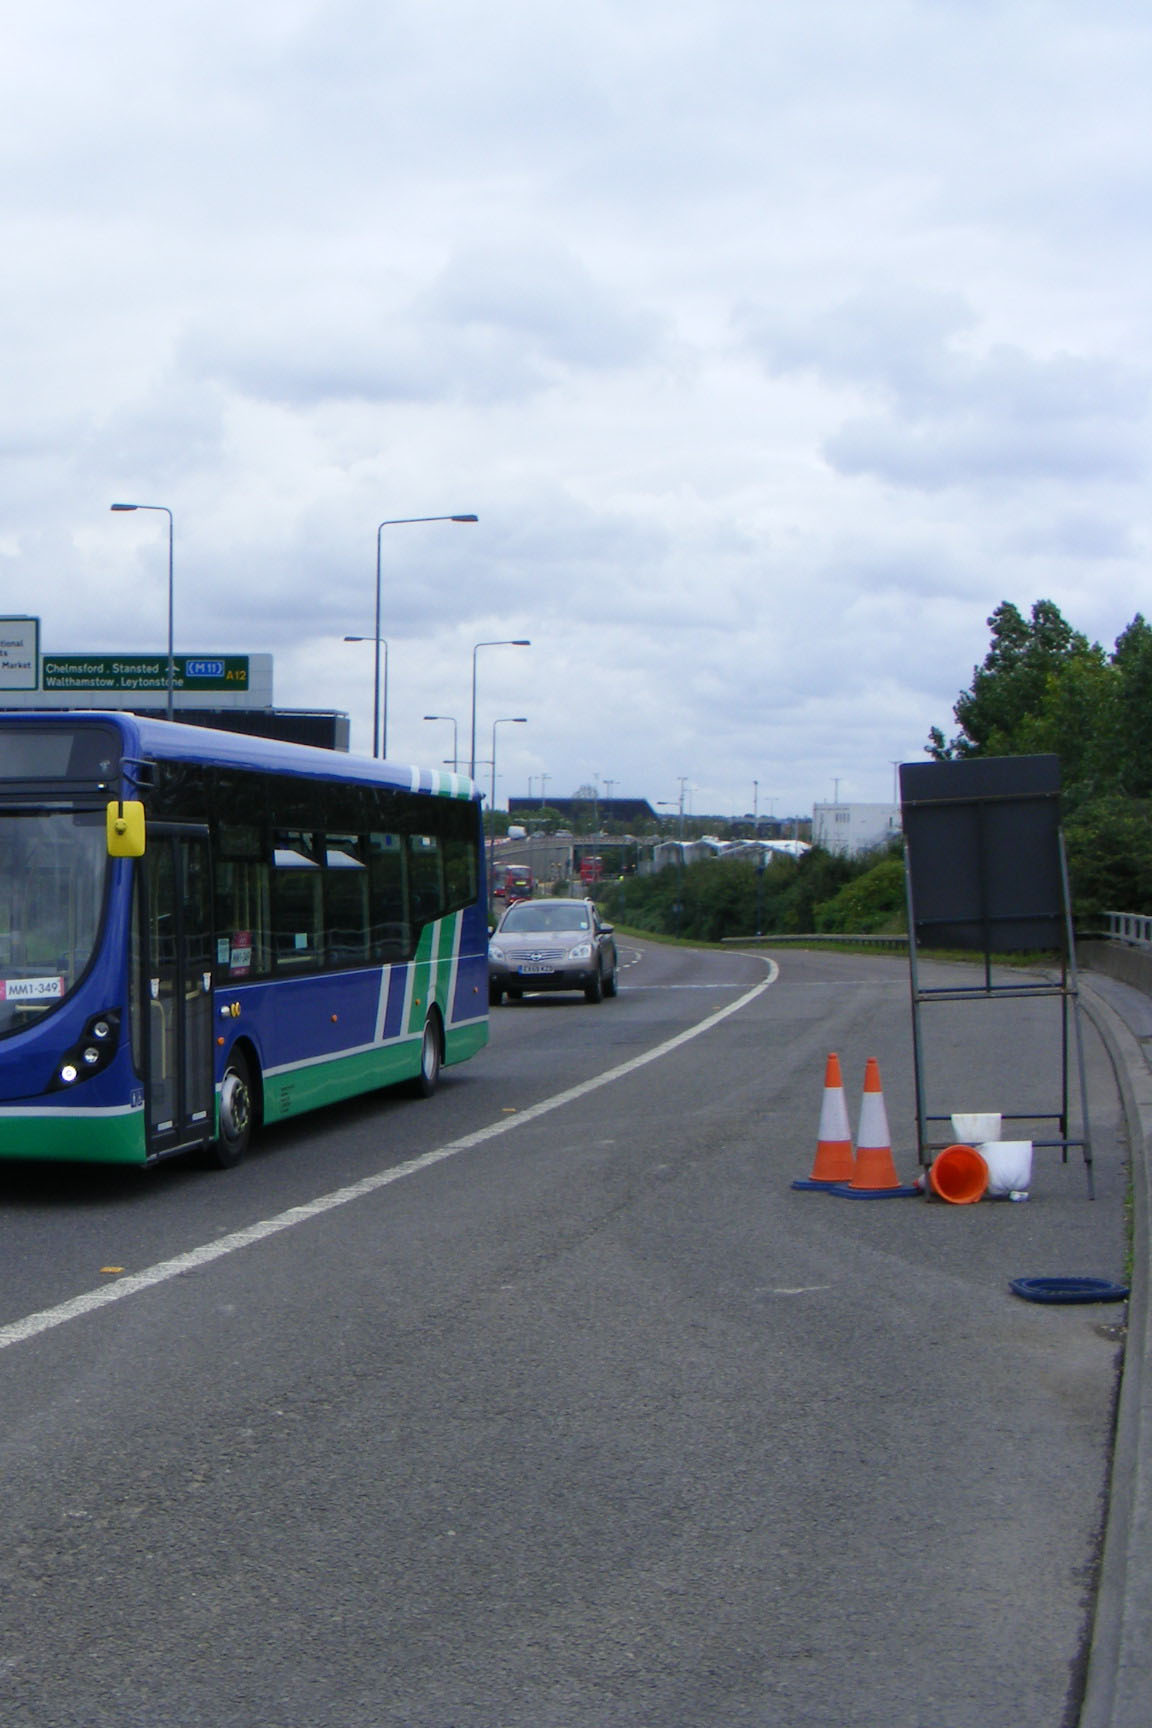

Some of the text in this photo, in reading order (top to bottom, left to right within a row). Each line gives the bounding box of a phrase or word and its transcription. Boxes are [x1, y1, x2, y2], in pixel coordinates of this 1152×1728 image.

[2, 661, 31, 669] Market
[46, 663, 159, 673] Chelmsford Stansted
[46, 677, 114, 687] Walthamstow
[9, 982, 58, 995] MM1-349
